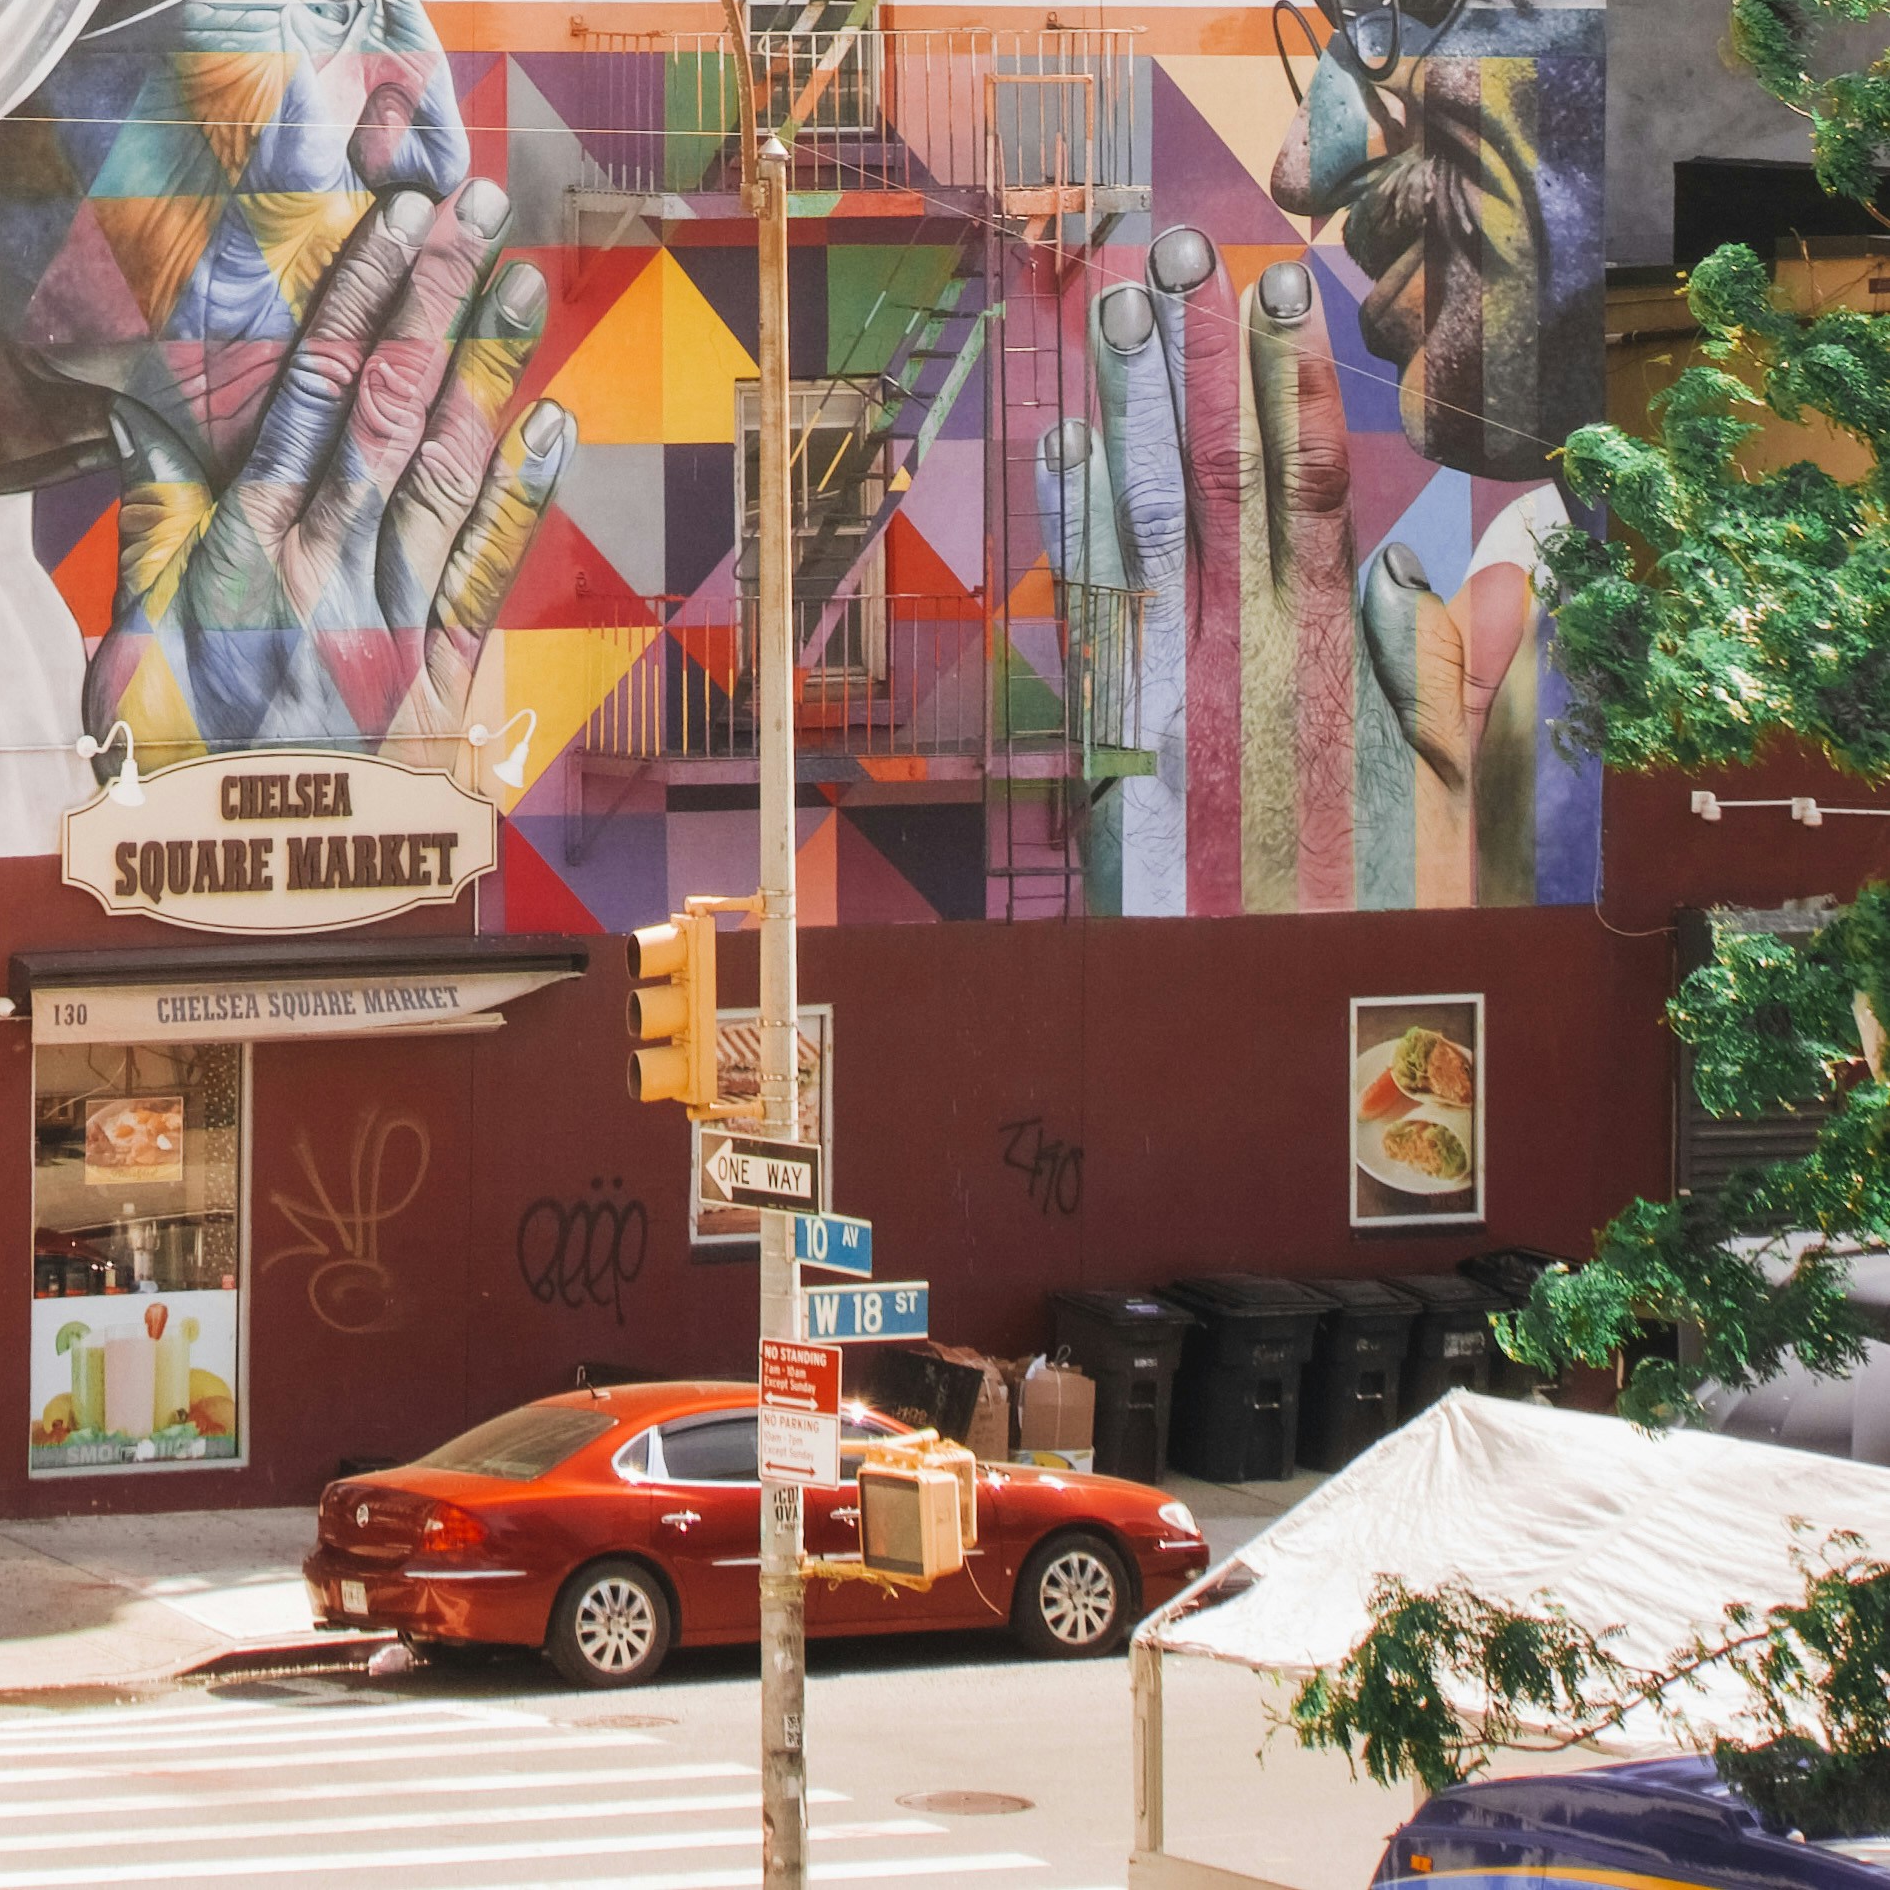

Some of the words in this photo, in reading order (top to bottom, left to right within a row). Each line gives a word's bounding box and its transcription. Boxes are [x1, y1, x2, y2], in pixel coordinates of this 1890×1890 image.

[220, 772, 353, 821] CHELSEA
[114, 837, 274, 905] SQUARE
[286, 832, 459, 891] MARKET
[53, 1003, 88, 1027] 130
[156, 992, 261, 1024] CHELSEA
[268, 990, 358, 1021] SQUARE
[363, 985, 461, 1014] MARKET
[717, 1155, 750, 1185] ONE
[767, 1161, 803, 1192] WAY
[804, 1218, 828, 1261] 10
[842, 1223, 859, 1248] AV
[813, 1294, 840, 1335] W
[853, 1292, 883, 1334] 18
[895, 1291, 918, 1314] ST
[764, 1344, 779, 1360] NO
[780, 1347, 827, 1368] STANDING
[764, 1363, 781, 1376] 7am
[787, 1365, 807, 1379] 10am
[764, 1375, 789, 1393] Except
[790, 1379, 817, 1396] Sunday
[764, 1413, 777, 1427] NO
[780, 1415, 820, 1434] PARKING
[764, 1430, 782, 1443] 10am
[788, 1433, 803, 1446] 7pm
[764, 1443, 787, 1458] Except
[789, 1446, 814, 1462] Sunday
